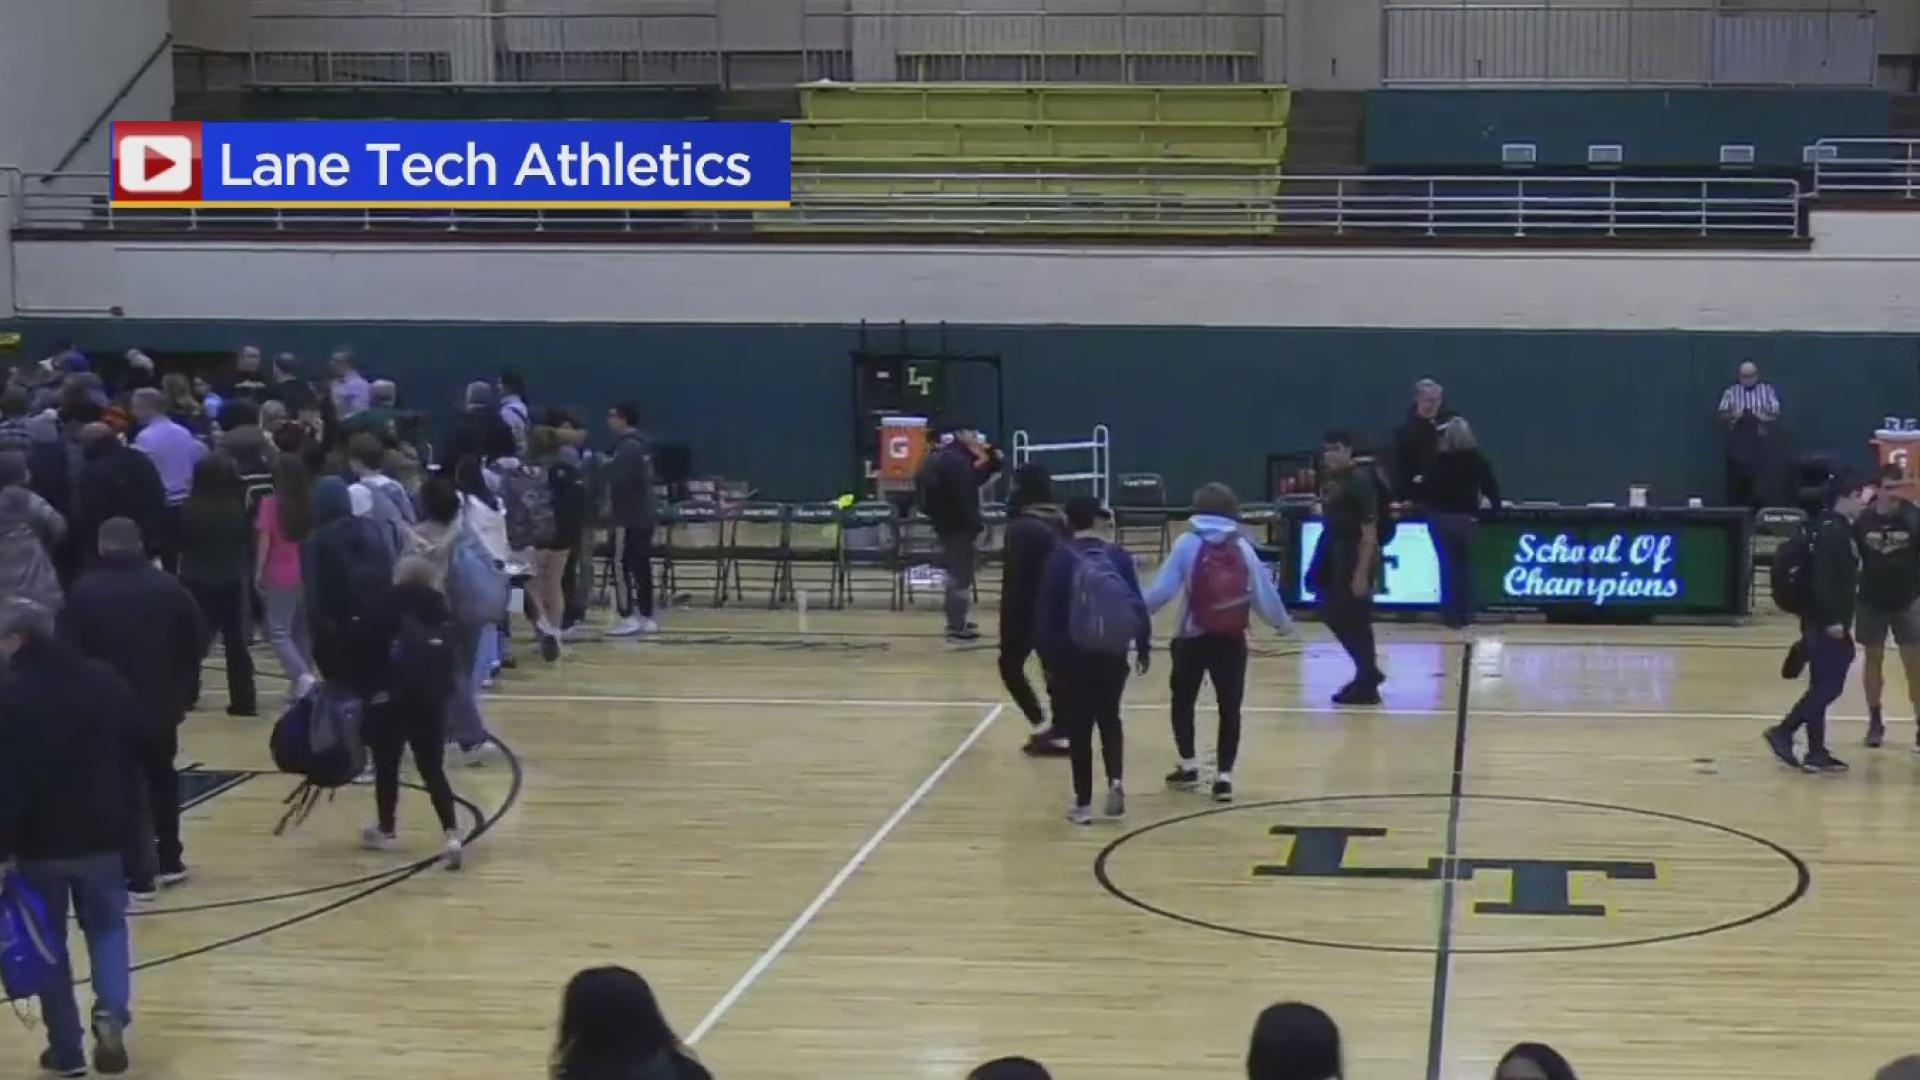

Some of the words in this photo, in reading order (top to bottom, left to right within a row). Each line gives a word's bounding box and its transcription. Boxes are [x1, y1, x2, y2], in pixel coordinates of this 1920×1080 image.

[908, 366, 933, 395] LT
[889, 436, 909, 459] G
[1514, 534, 1623, 564] School
[1629, 534, 1673, 573] Of
[1503, 566, 1678, 606] Champions
[1252, 824, 1658, 917] LT
